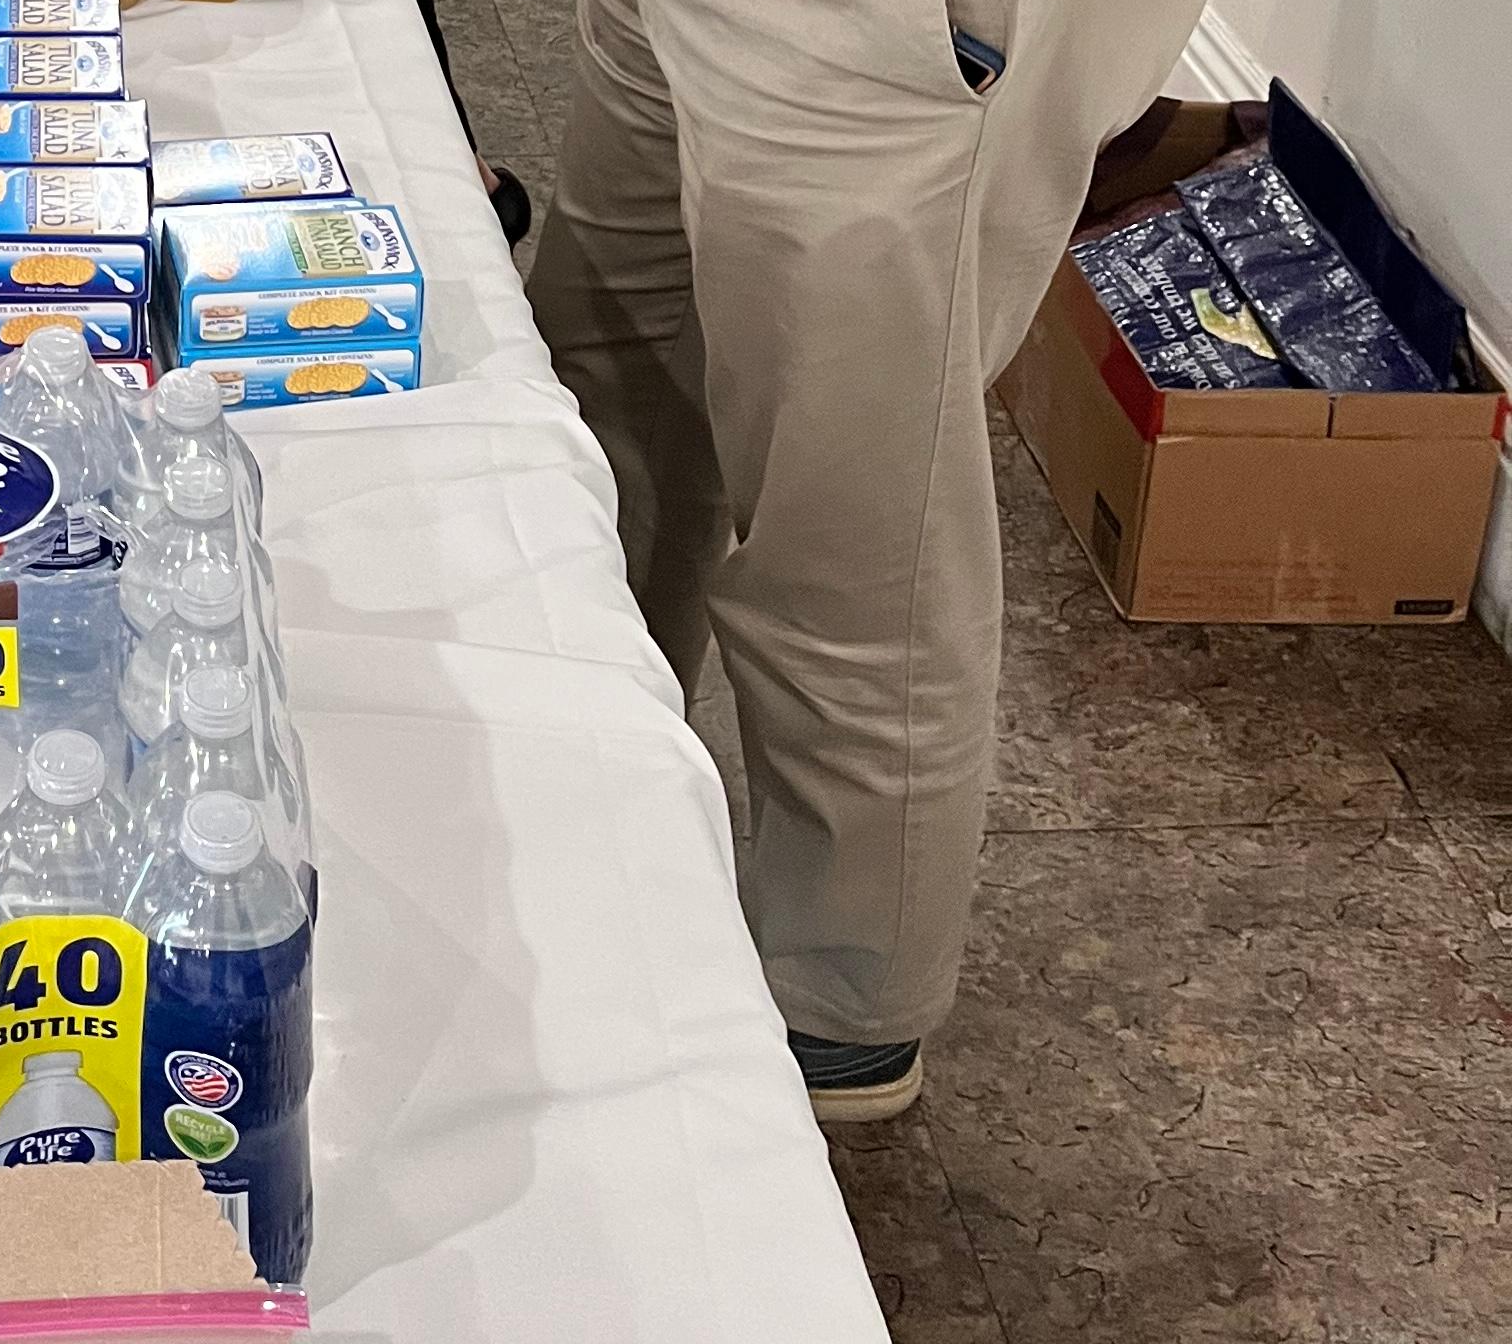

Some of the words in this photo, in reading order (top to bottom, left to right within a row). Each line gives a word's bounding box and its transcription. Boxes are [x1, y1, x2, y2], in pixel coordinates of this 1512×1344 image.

[23, 43, 46, 86] SALAD
[48, 45, 73, 85] TUNA
[43, 107, 68, 156] SALAD
[72, 111, 96, 153] TUNA
[40, 175, 66, 226] SALAD
[69, 177, 94, 224] TUNA
[22, 245, 46, 253] SNACK
[328, 217, 364, 269] RANCH
[36, 305, 49, 313] KIT
[19, 1130, 81, 1153] Pure
[175, 1112, 225, 1135] RECYCLE
[26, 1143, 73, 1163] Life
